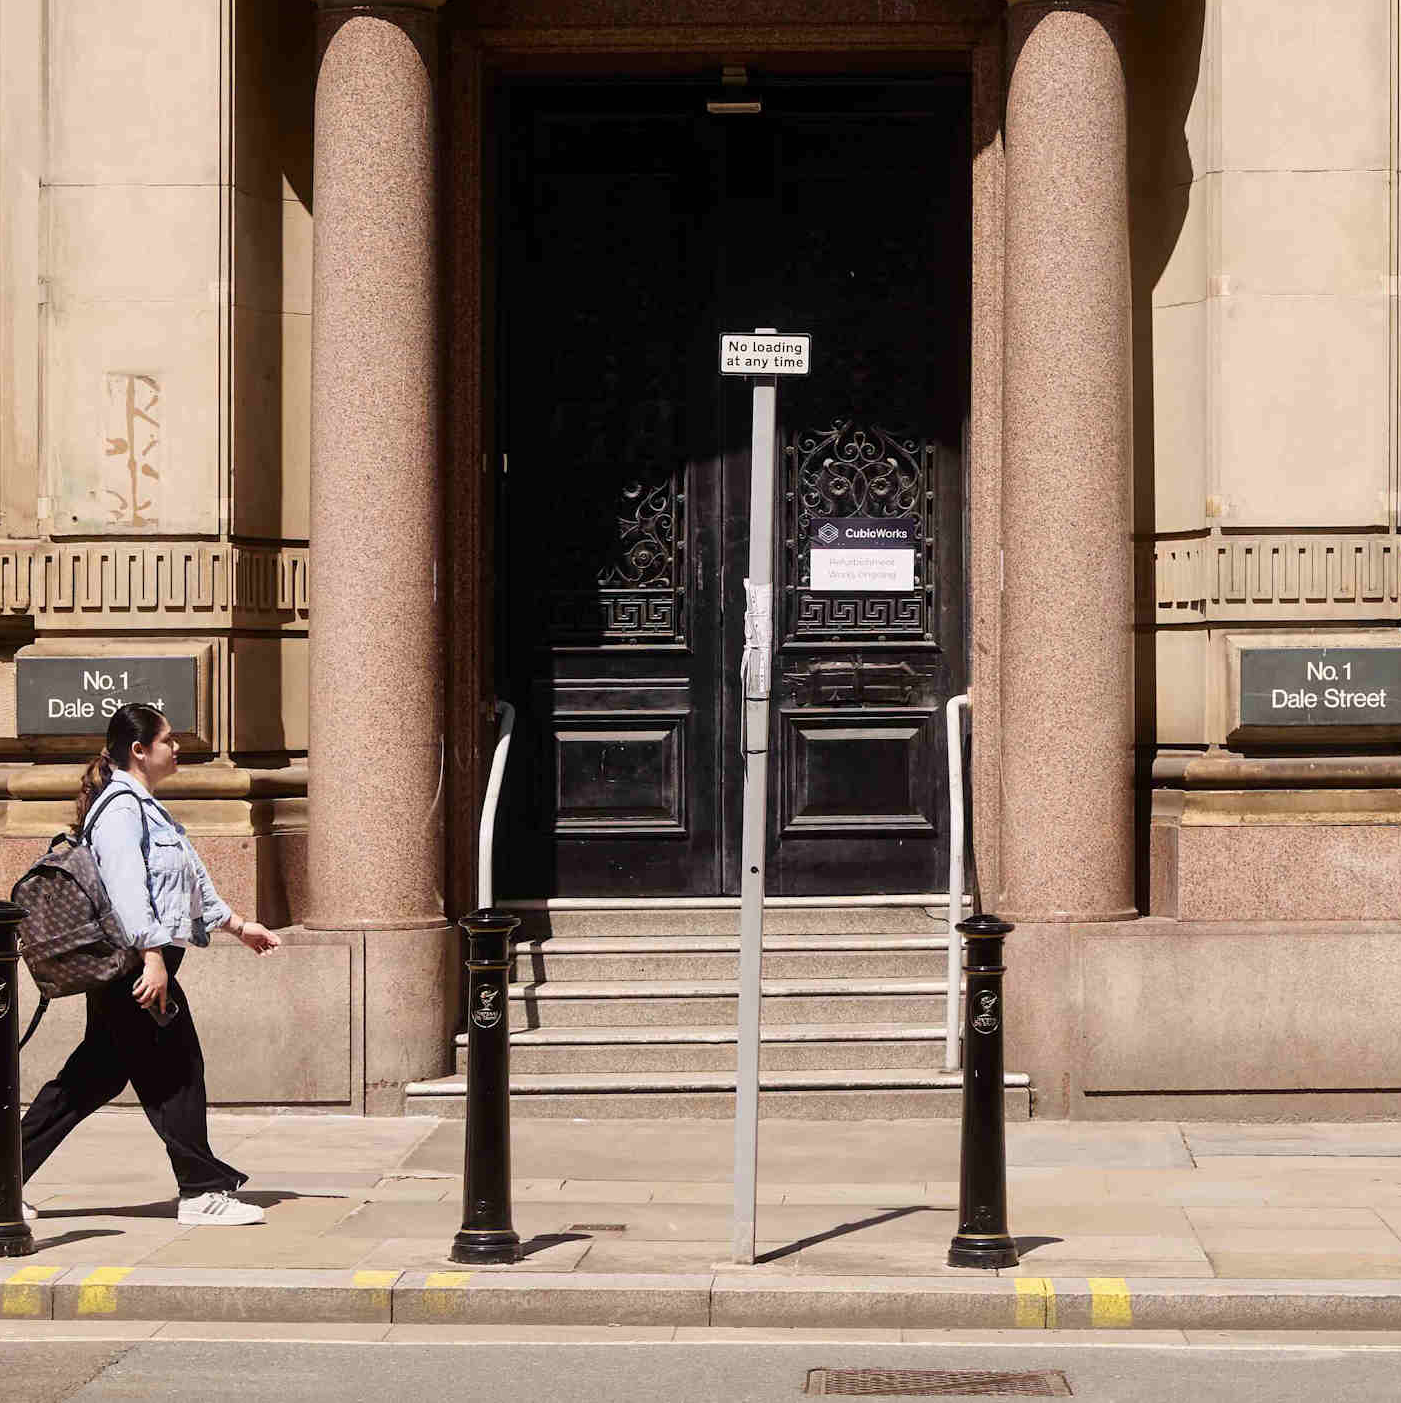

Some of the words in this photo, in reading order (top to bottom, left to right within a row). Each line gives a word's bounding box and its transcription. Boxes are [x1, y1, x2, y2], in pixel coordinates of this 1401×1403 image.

[729, 342, 748, 352] No
[753, 341, 802, 355] loading
[727, 356, 740, 366] at
[745, 358, 768, 369] any
[774, 356, 803, 367] time
[845, 528, 908, 539] CubicWorks
[83, 670, 115, 690] No.
[119, 670, 128, 690] 1
[1307, 661, 1339, 681] No.
[1342, 662, 1352, 681] 1
[48, 698, 94, 718] Dale
[1271, 688, 1318, 708] Dale
[1323, 688, 1387, 708] Street
